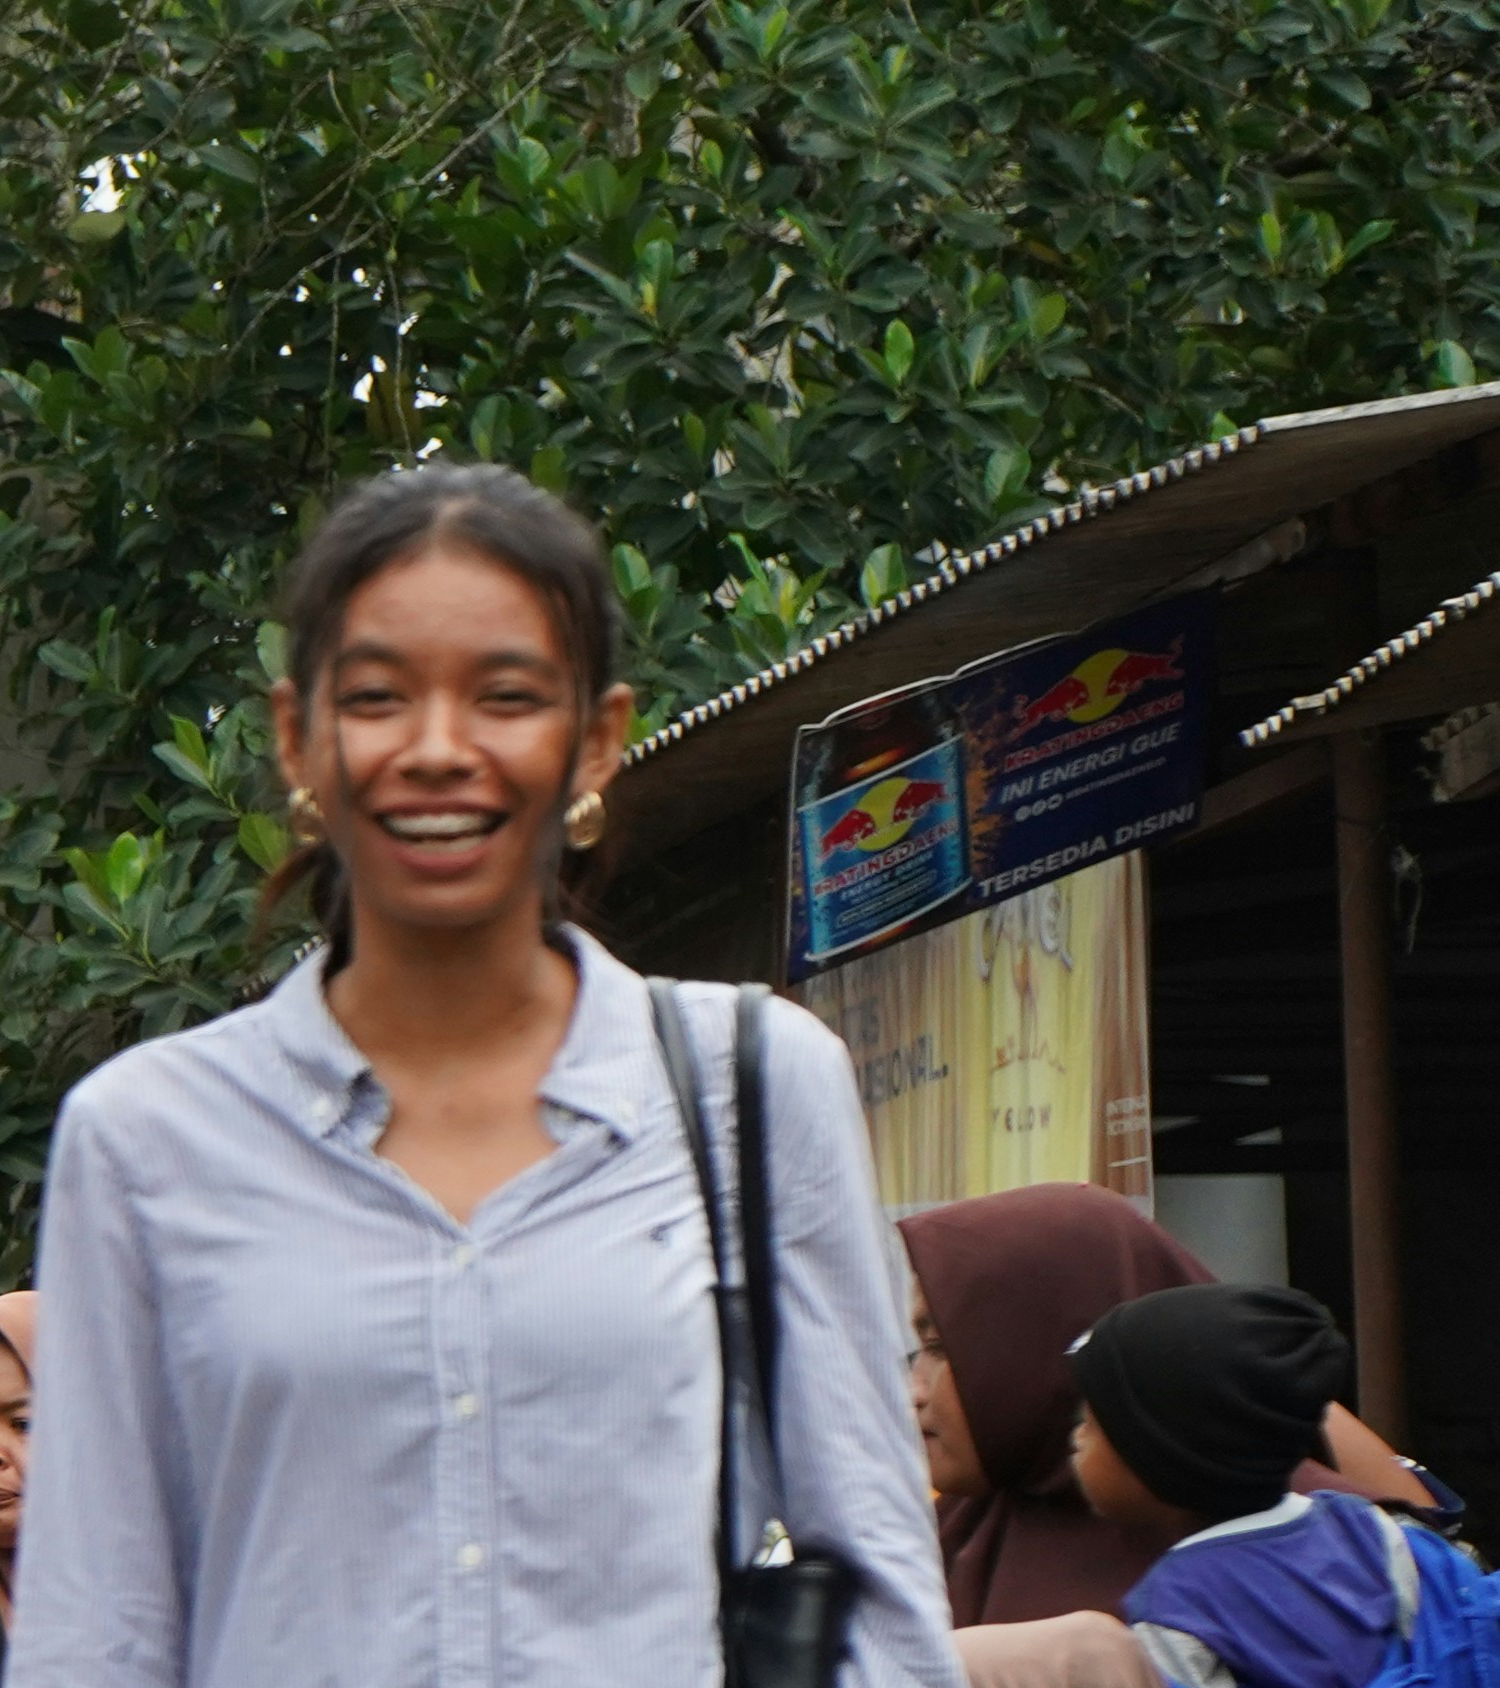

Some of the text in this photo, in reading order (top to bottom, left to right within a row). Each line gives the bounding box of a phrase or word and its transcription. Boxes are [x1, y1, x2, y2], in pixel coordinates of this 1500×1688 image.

[1000, 777, 1035, 804] INI
[1037, 743, 1127, 791] ENERGI
[1130, 720, 1183, 755] GUE
[978, 834, 1108, 898] TERSEDIA
[1115, 802, 1197, 847] DISINI
